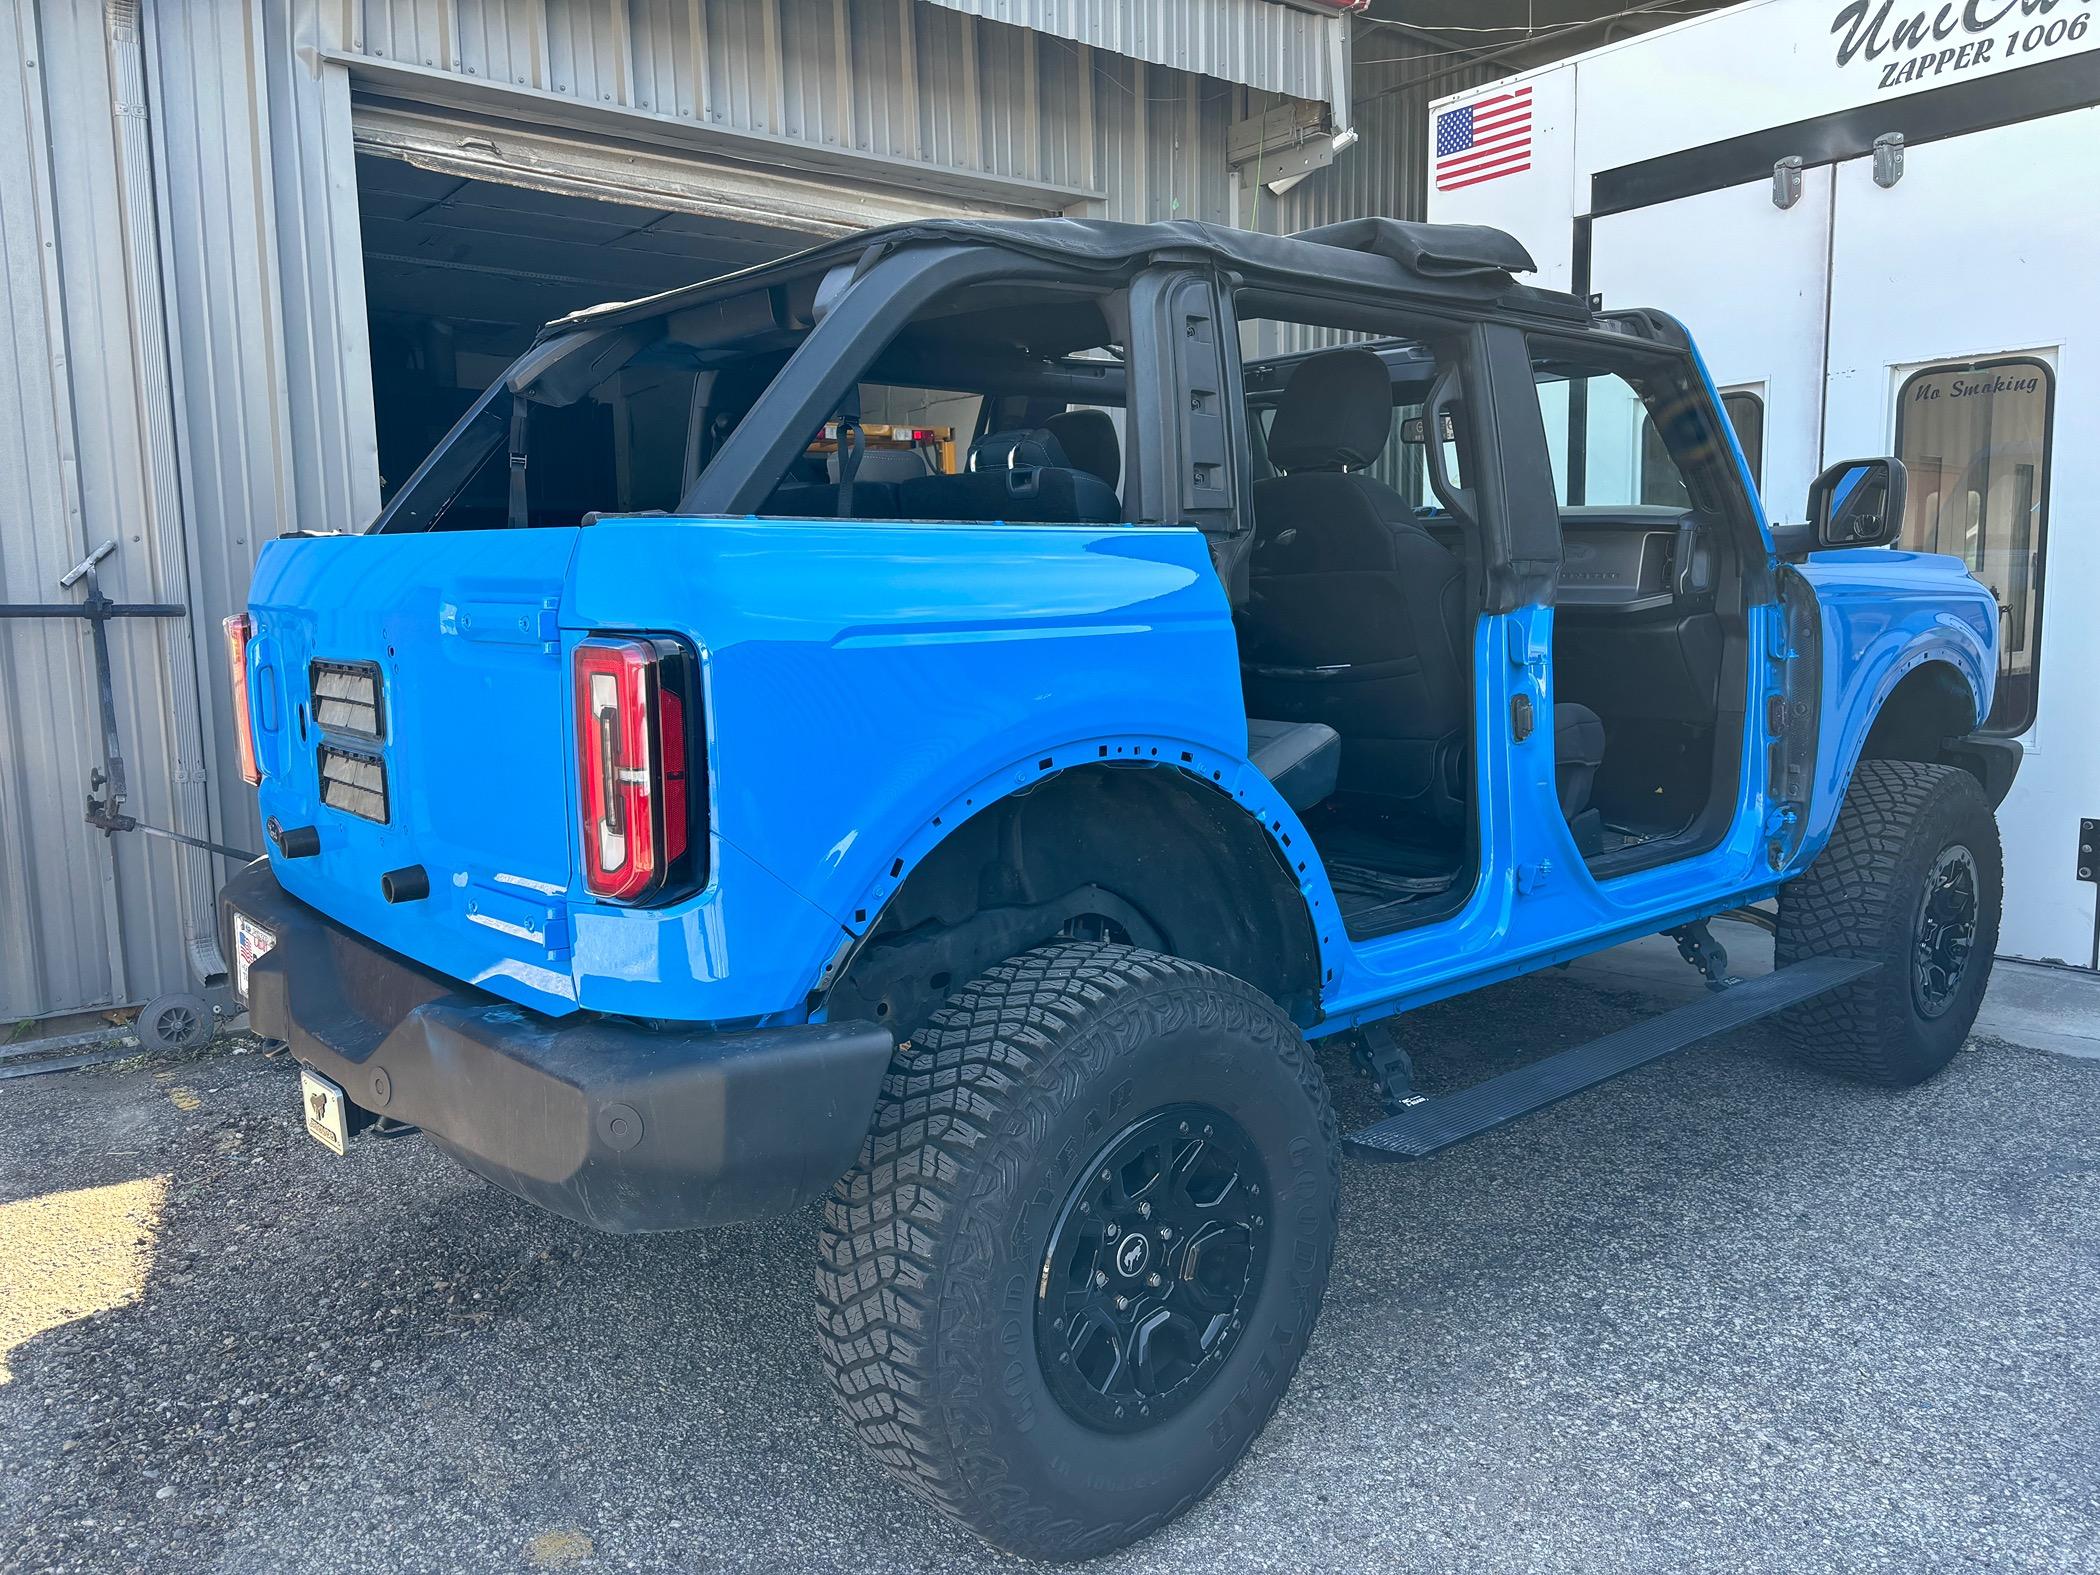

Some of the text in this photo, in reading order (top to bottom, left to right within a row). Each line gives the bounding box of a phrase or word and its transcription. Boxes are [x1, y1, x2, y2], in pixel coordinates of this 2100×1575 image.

[1878, 12, 2091, 89] ZAPPER 1006
[1915, 376, 2038, 402] No Smoking
